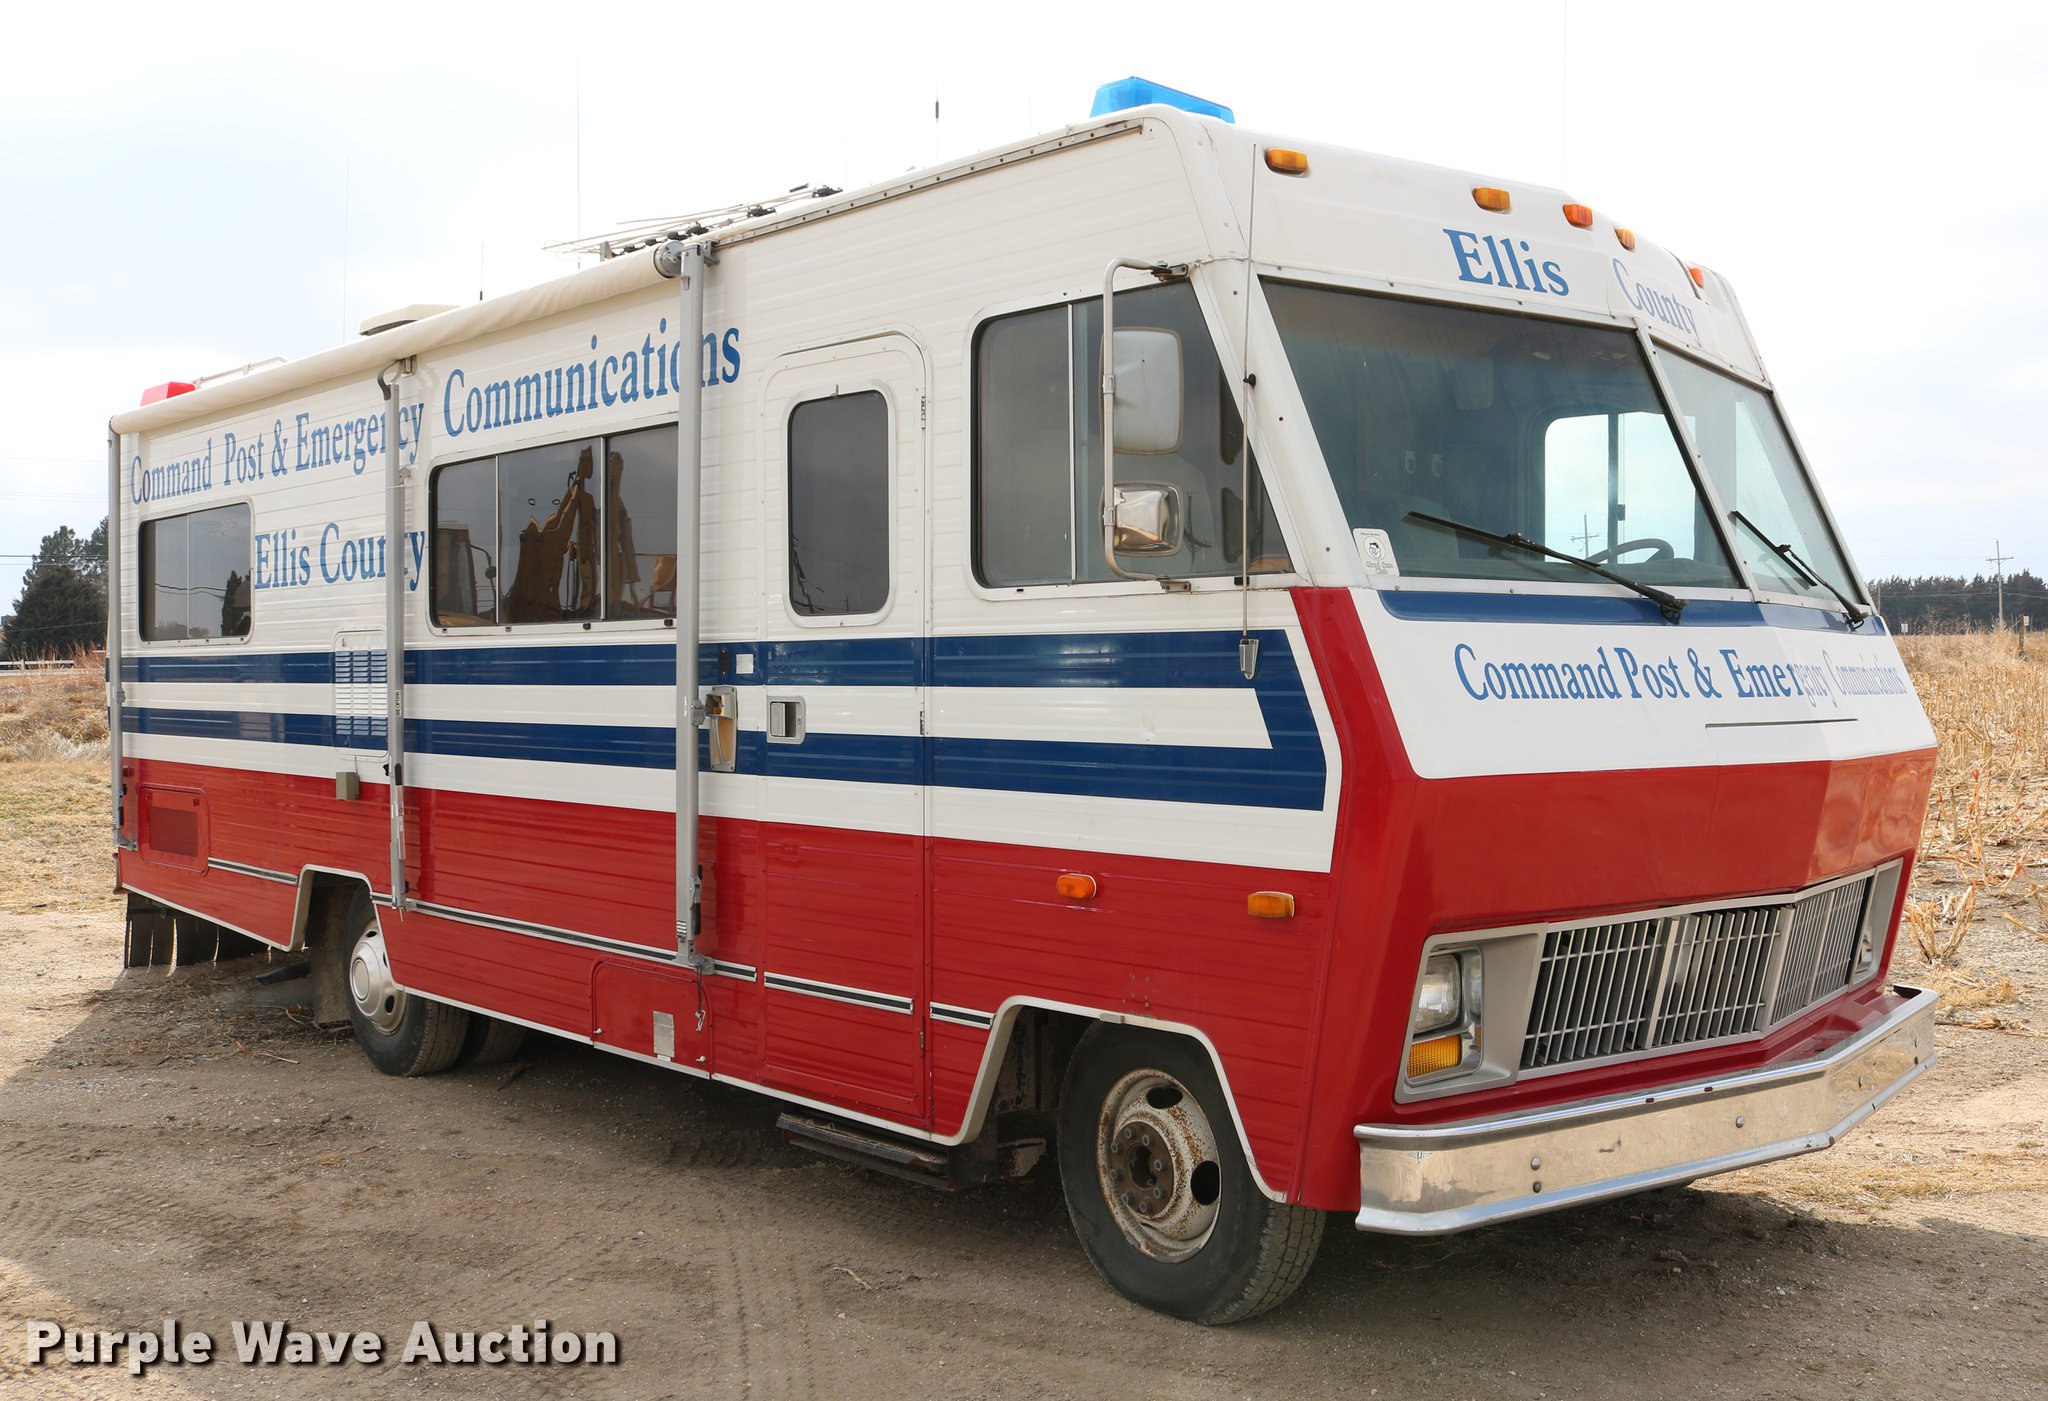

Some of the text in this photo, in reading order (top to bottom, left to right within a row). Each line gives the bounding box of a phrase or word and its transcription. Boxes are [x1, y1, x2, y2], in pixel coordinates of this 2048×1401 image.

[1442, 228, 1702, 349] Ellis County
[131, 437, 212, 505] Command
[224, 432, 264, 486] Post
[271, 418, 288, 477] &
[254, 522, 425, 592] Ellis Couy
[1454, 643, 1622, 700] Command
[1614, 647, 1691, 699] Post
[1687, 647, 1723, 699] &
[1719, 649, 1838, 709] Emergency
